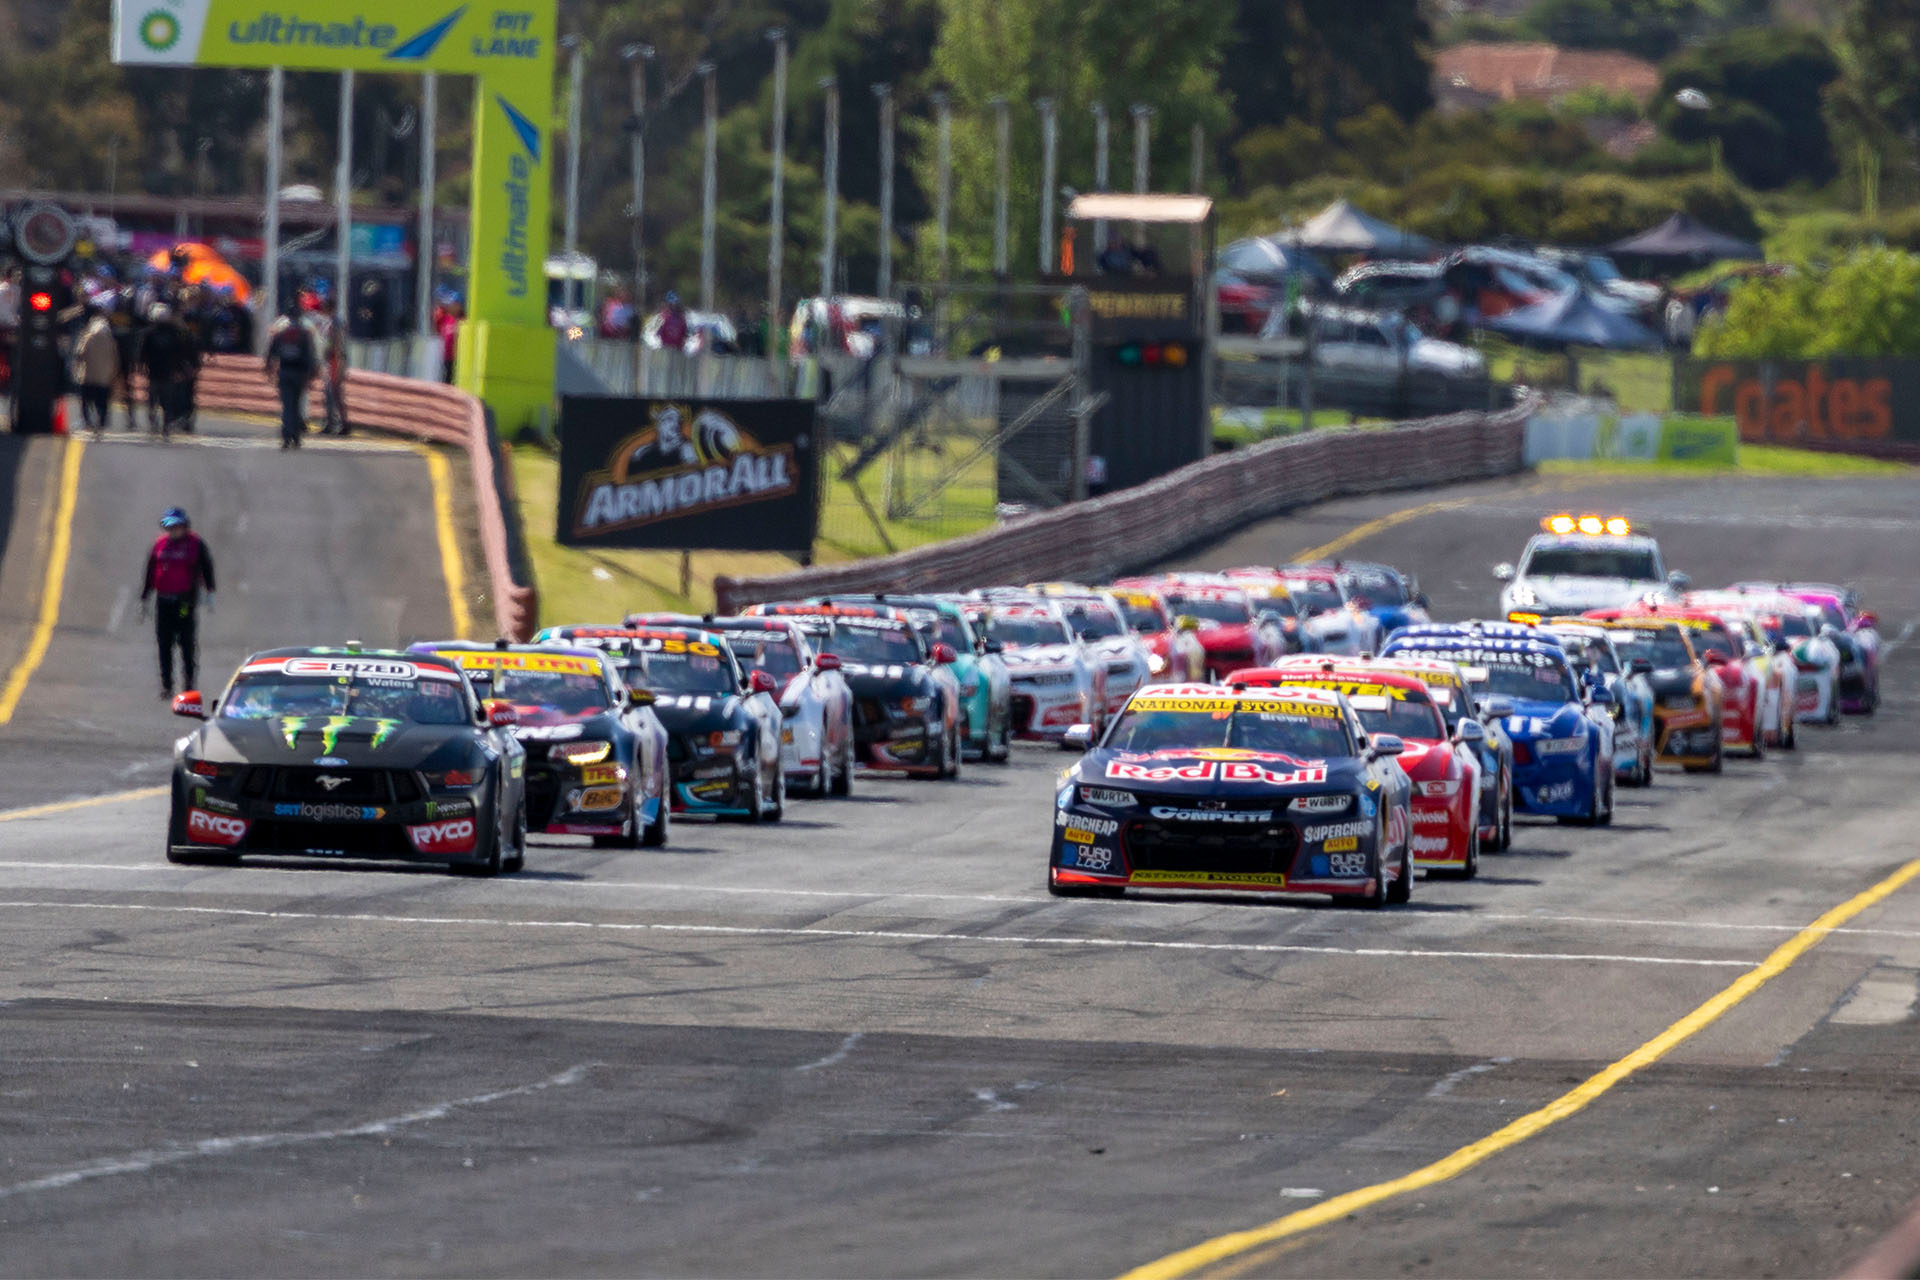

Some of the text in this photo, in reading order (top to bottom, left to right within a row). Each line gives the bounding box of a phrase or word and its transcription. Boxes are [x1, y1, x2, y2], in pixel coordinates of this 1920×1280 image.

[490, 10, 533, 33] PIT
[228, 13, 397, 48] ultimate
[470, 36, 541, 59] LANE
[500, 153, 533, 298] ultimate
[1700, 364, 1893, 439] Coates
[1394, 649, 1523, 664] steadfast
[330, 663, 403, 674] ENZED
[368, 678, 414, 689] Waters
[1132, 700, 1335, 717] NATIONAL STORAGE
[1259, 713, 1308, 723] Brown
[1105, 761, 1328, 785] Red Bull
[1150, 806, 1273, 822] COMPLETE
[190, 810, 247, 837] RYCO
[1055, 810, 1119, 837] SUPERCHEAP
[412, 820, 474, 845] RYCO
[1067, 831, 1092, 843] AUTO
[1326, 838, 1355, 851] AUTO
[1078, 845, 1112, 862] QUAD
[1075, 857, 1111, 871] LOCK
